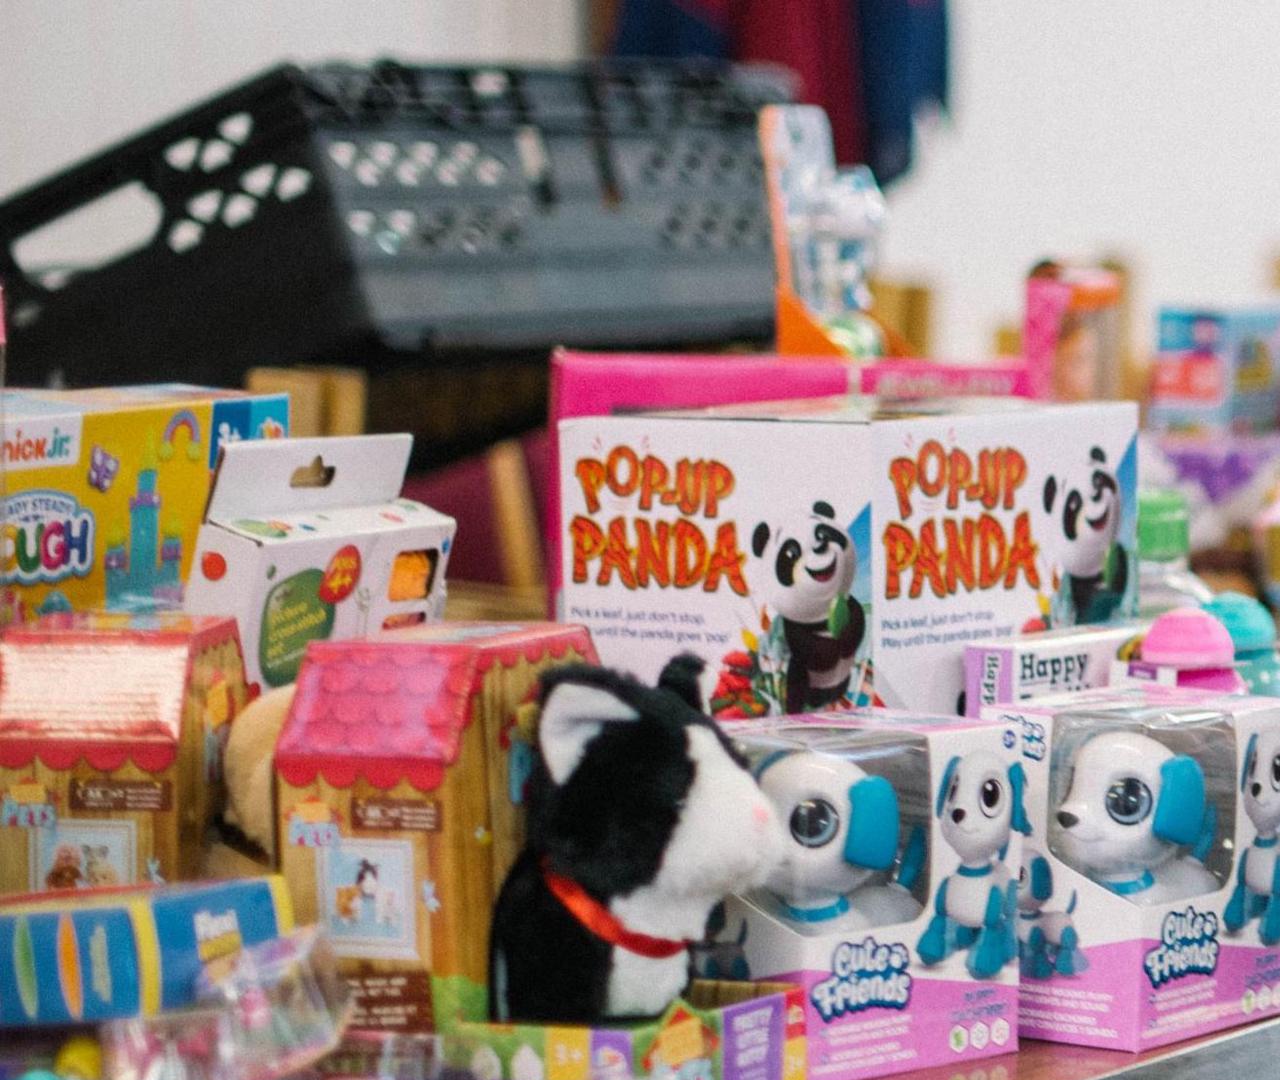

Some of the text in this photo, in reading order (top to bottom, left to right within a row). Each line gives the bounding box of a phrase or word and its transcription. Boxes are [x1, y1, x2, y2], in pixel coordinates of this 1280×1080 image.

[46, 426, 71, 459] jr.
[573, 444, 736, 518] POP-UP
[888, 438, 1028, 520] POP-UP
[568, 514, 749, 597] PANDA
[881, 510, 1042, 601] PANDA
[620, 627, 638, 638] the
[640, 629, 674, 642] panda
[982, 655, 999, 705] Happ
[1017, 652, 1089, 685] Happy
[1160, 905, 1220, 949] Cute
[831, 935, 911, 981] Cute
[1141, 938, 1222, 989] Friends
[809, 972, 914, 1024] Friends
